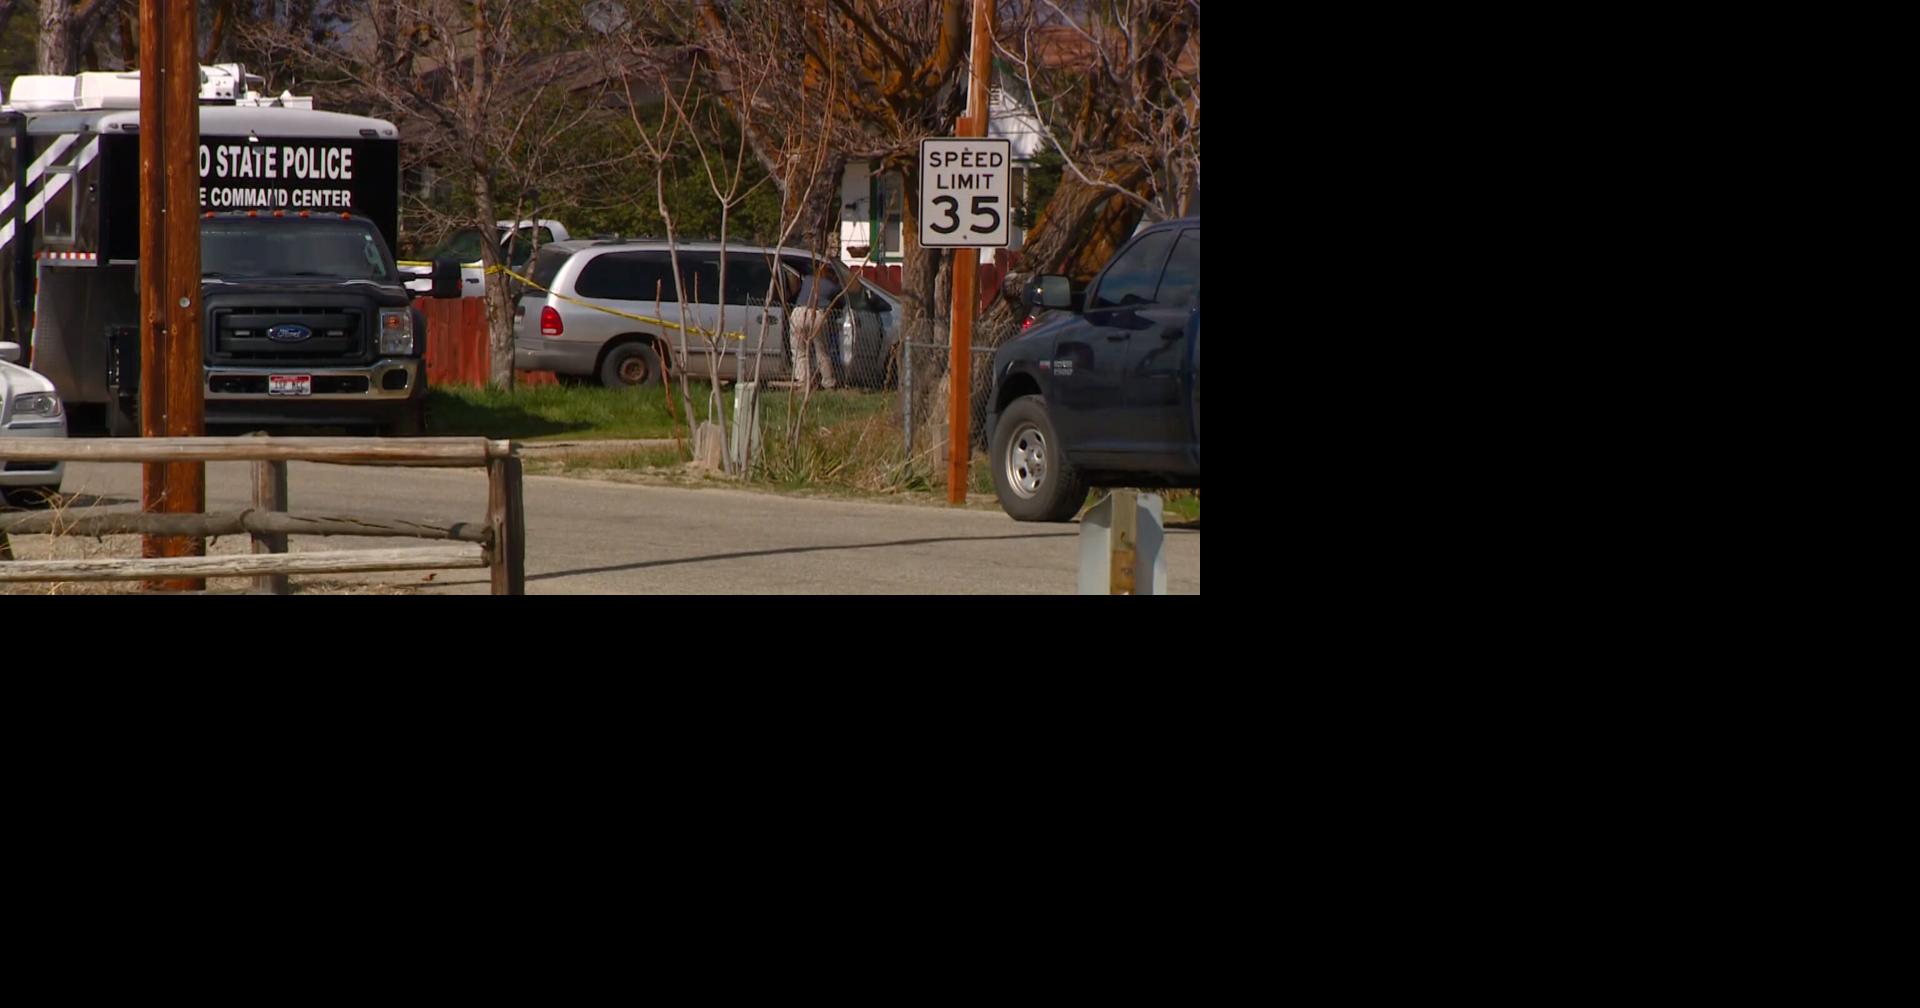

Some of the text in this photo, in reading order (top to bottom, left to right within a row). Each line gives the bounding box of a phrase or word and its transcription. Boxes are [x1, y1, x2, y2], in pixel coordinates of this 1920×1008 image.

[216, 145, 277, 178] STATE
[283, 146, 352, 180] POLICE
[929, 151, 1003, 168] SPEED
[937, 174, 994, 190] LIMIT
[292, 189, 351, 207] CENTER
[929, 195, 1000, 234] 35
